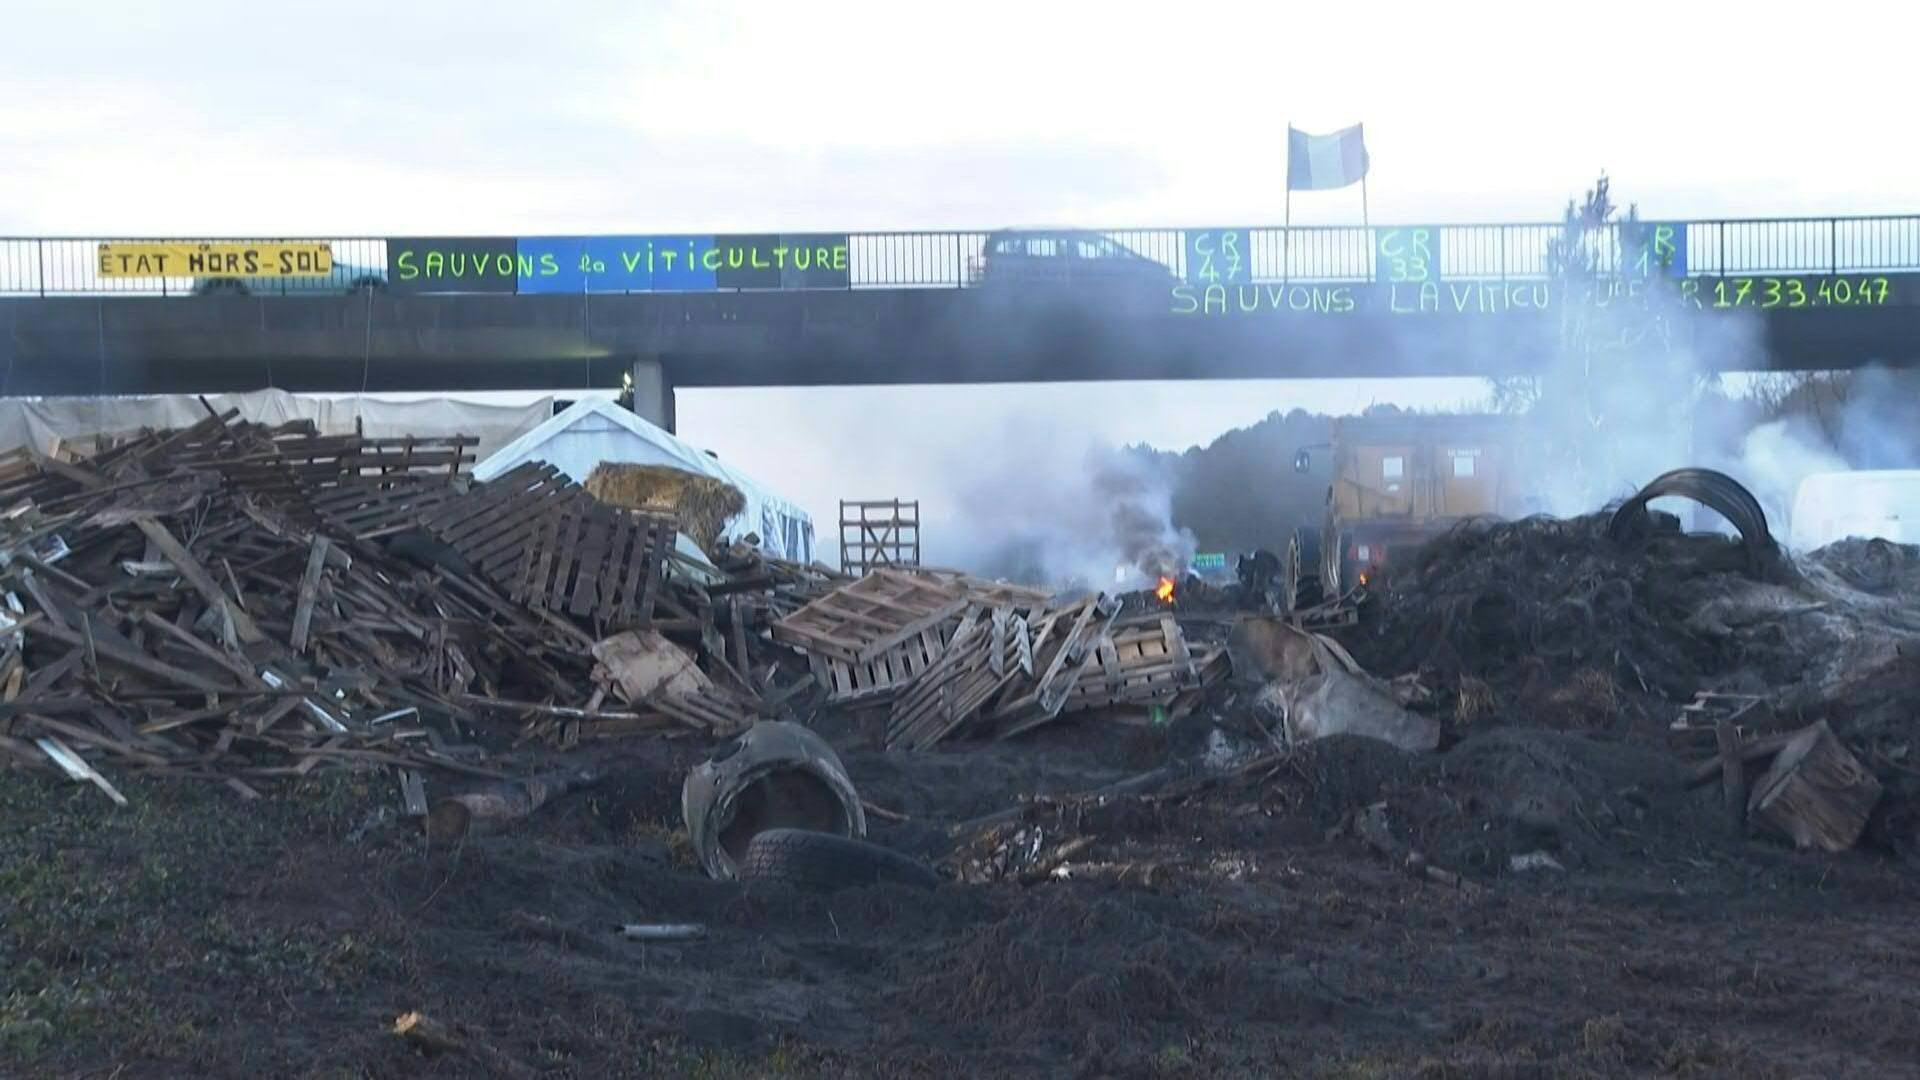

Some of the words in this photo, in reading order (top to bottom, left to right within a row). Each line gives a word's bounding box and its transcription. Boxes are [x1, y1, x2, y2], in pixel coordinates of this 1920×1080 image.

[1195, 232, 1240, 258] CR
[1381, 229, 1431, 260] CR
[101, 253, 170, 273] ETAT
[189, 249, 329, 274] HORS-SOL
[399, 250, 559, 279] SAUVONS
[1199, 255, 1242, 283] 47
[1389, 256, 1429, 282] 33
[1171, 284, 1355, 315] SAUVONS
[1390, 281, 1440, 313] LA
[1712, 278, 1890, 308] 17.33.40.47
